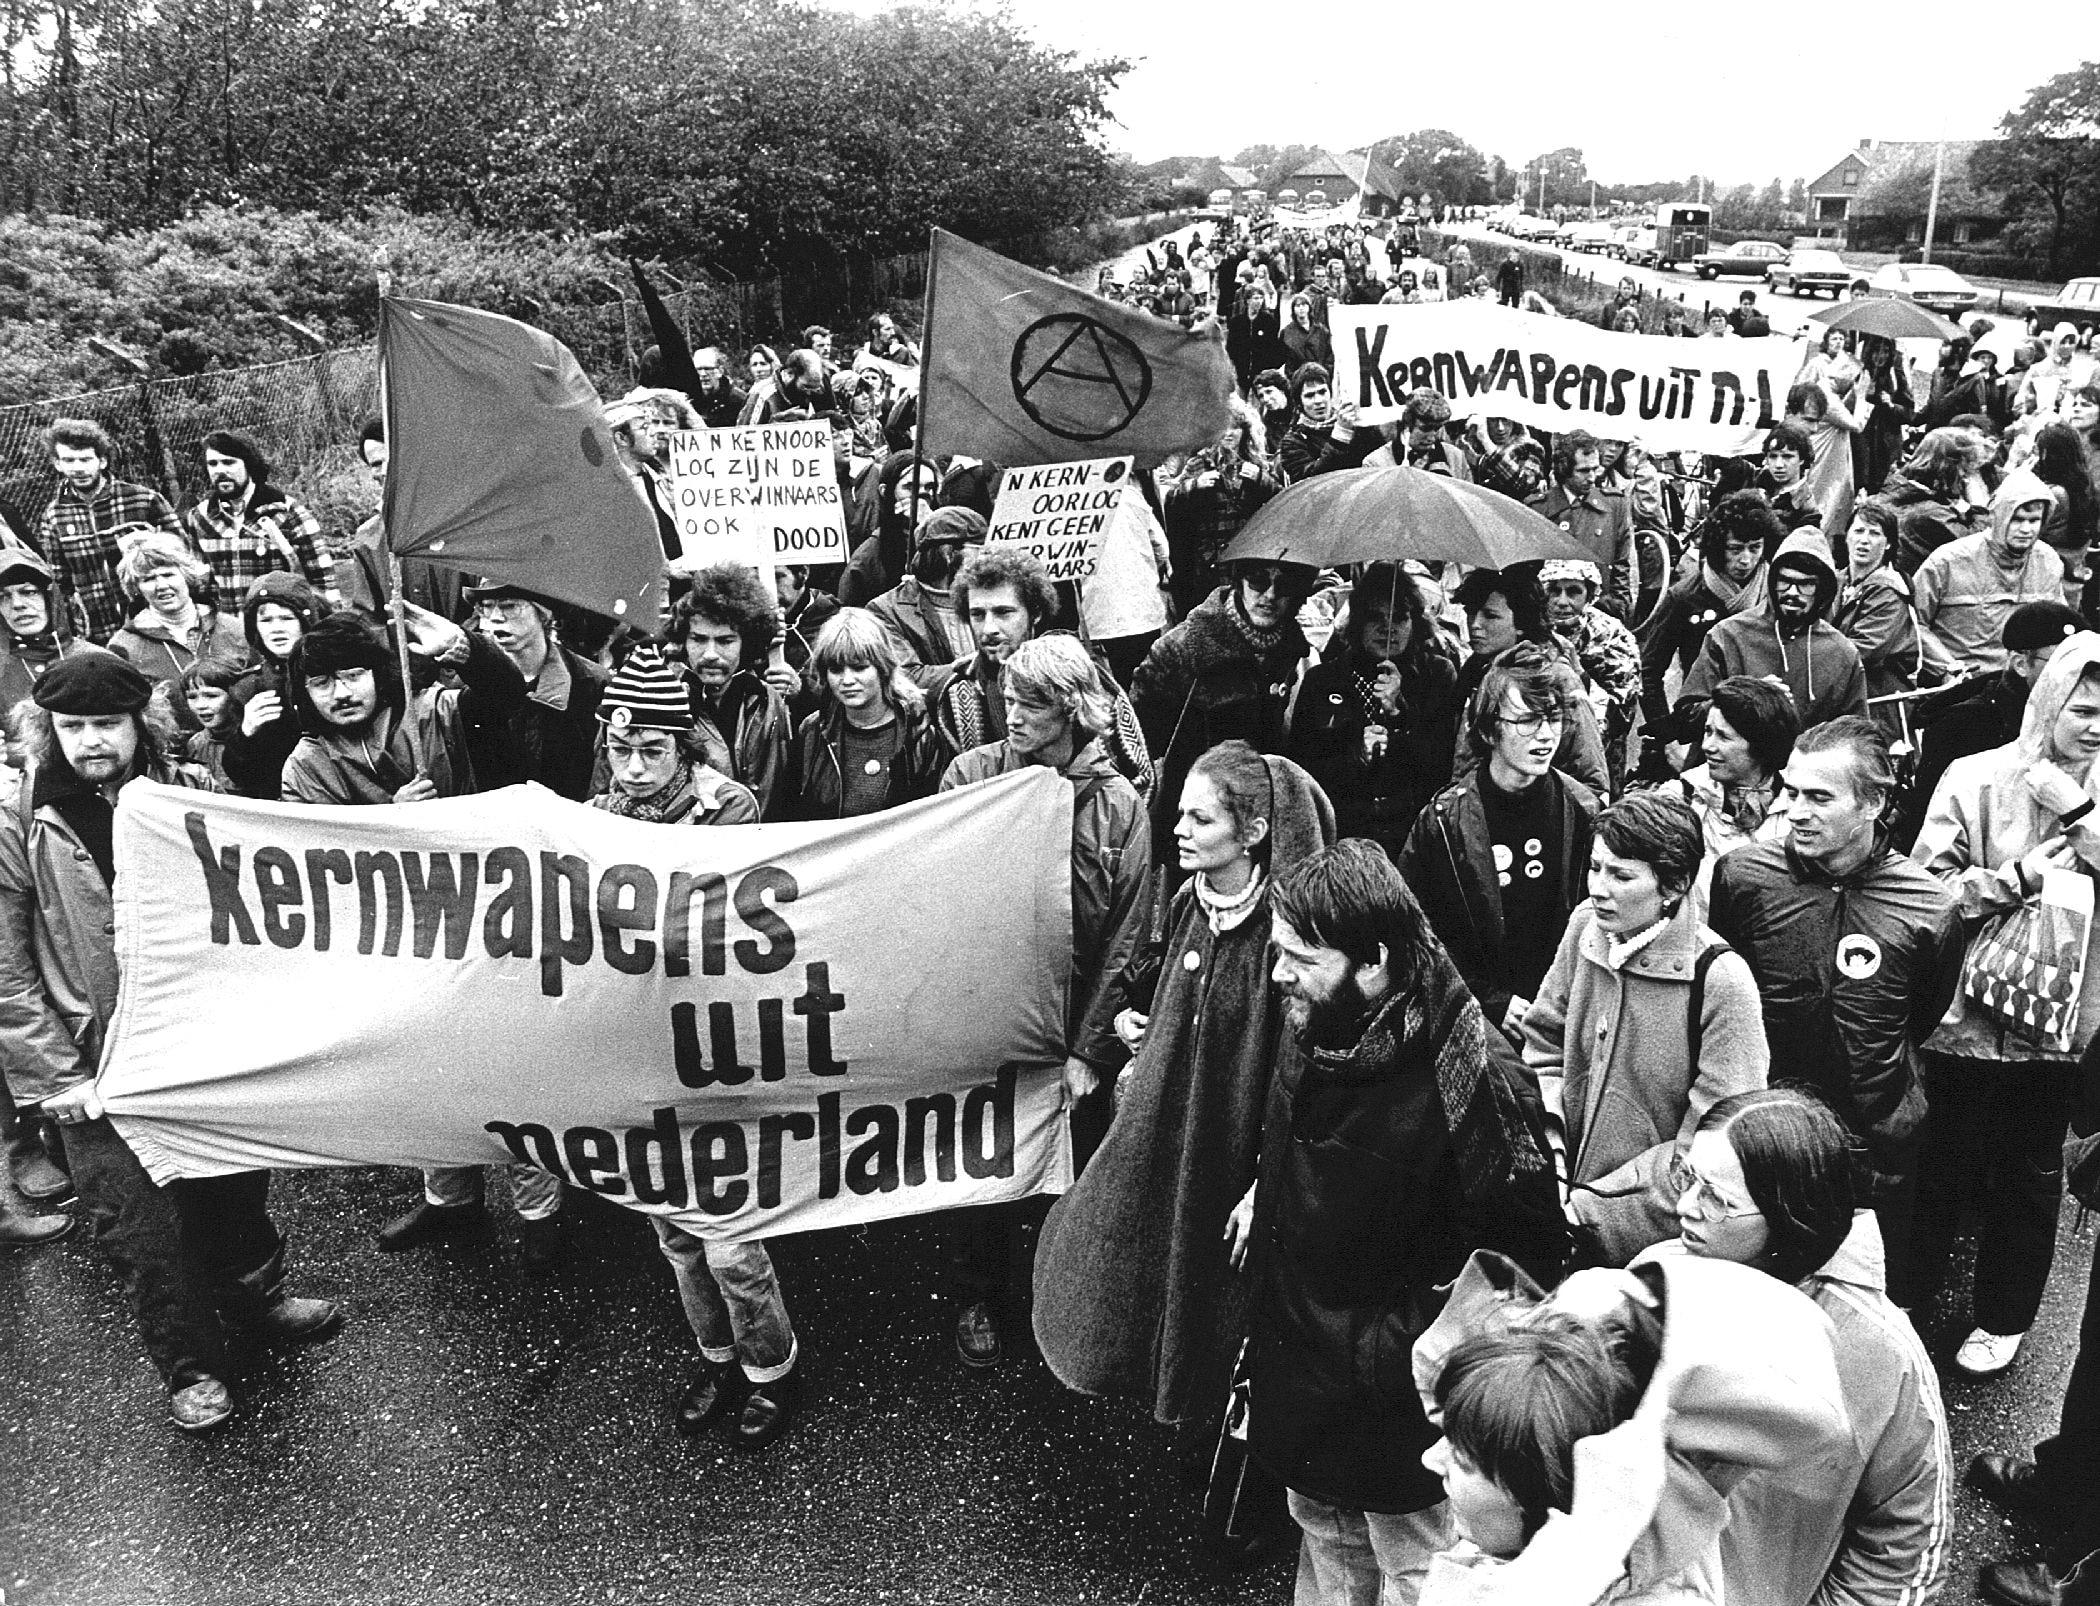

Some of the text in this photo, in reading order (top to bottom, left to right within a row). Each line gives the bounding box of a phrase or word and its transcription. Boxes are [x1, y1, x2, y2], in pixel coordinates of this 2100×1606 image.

[673, 432, 701, 453] NA
[675, 454, 821, 484] LOG ZIJN DE
[1028, 464, 1100, 490] KERN-
[681, 485, 838, 508] OVERWINNAARS
[1032, 489, 1122, 515] OORLOG
[685, 516, 740, 535] OOK
[990, 514, 1106, 541] KENT GEEN
[773, 526, 840, 553] DOOD
[185, 811, 799, 998] kernwapens
[671, 961, 848, 1089] uit
[484, 1062, 1016, 1217] nederland
